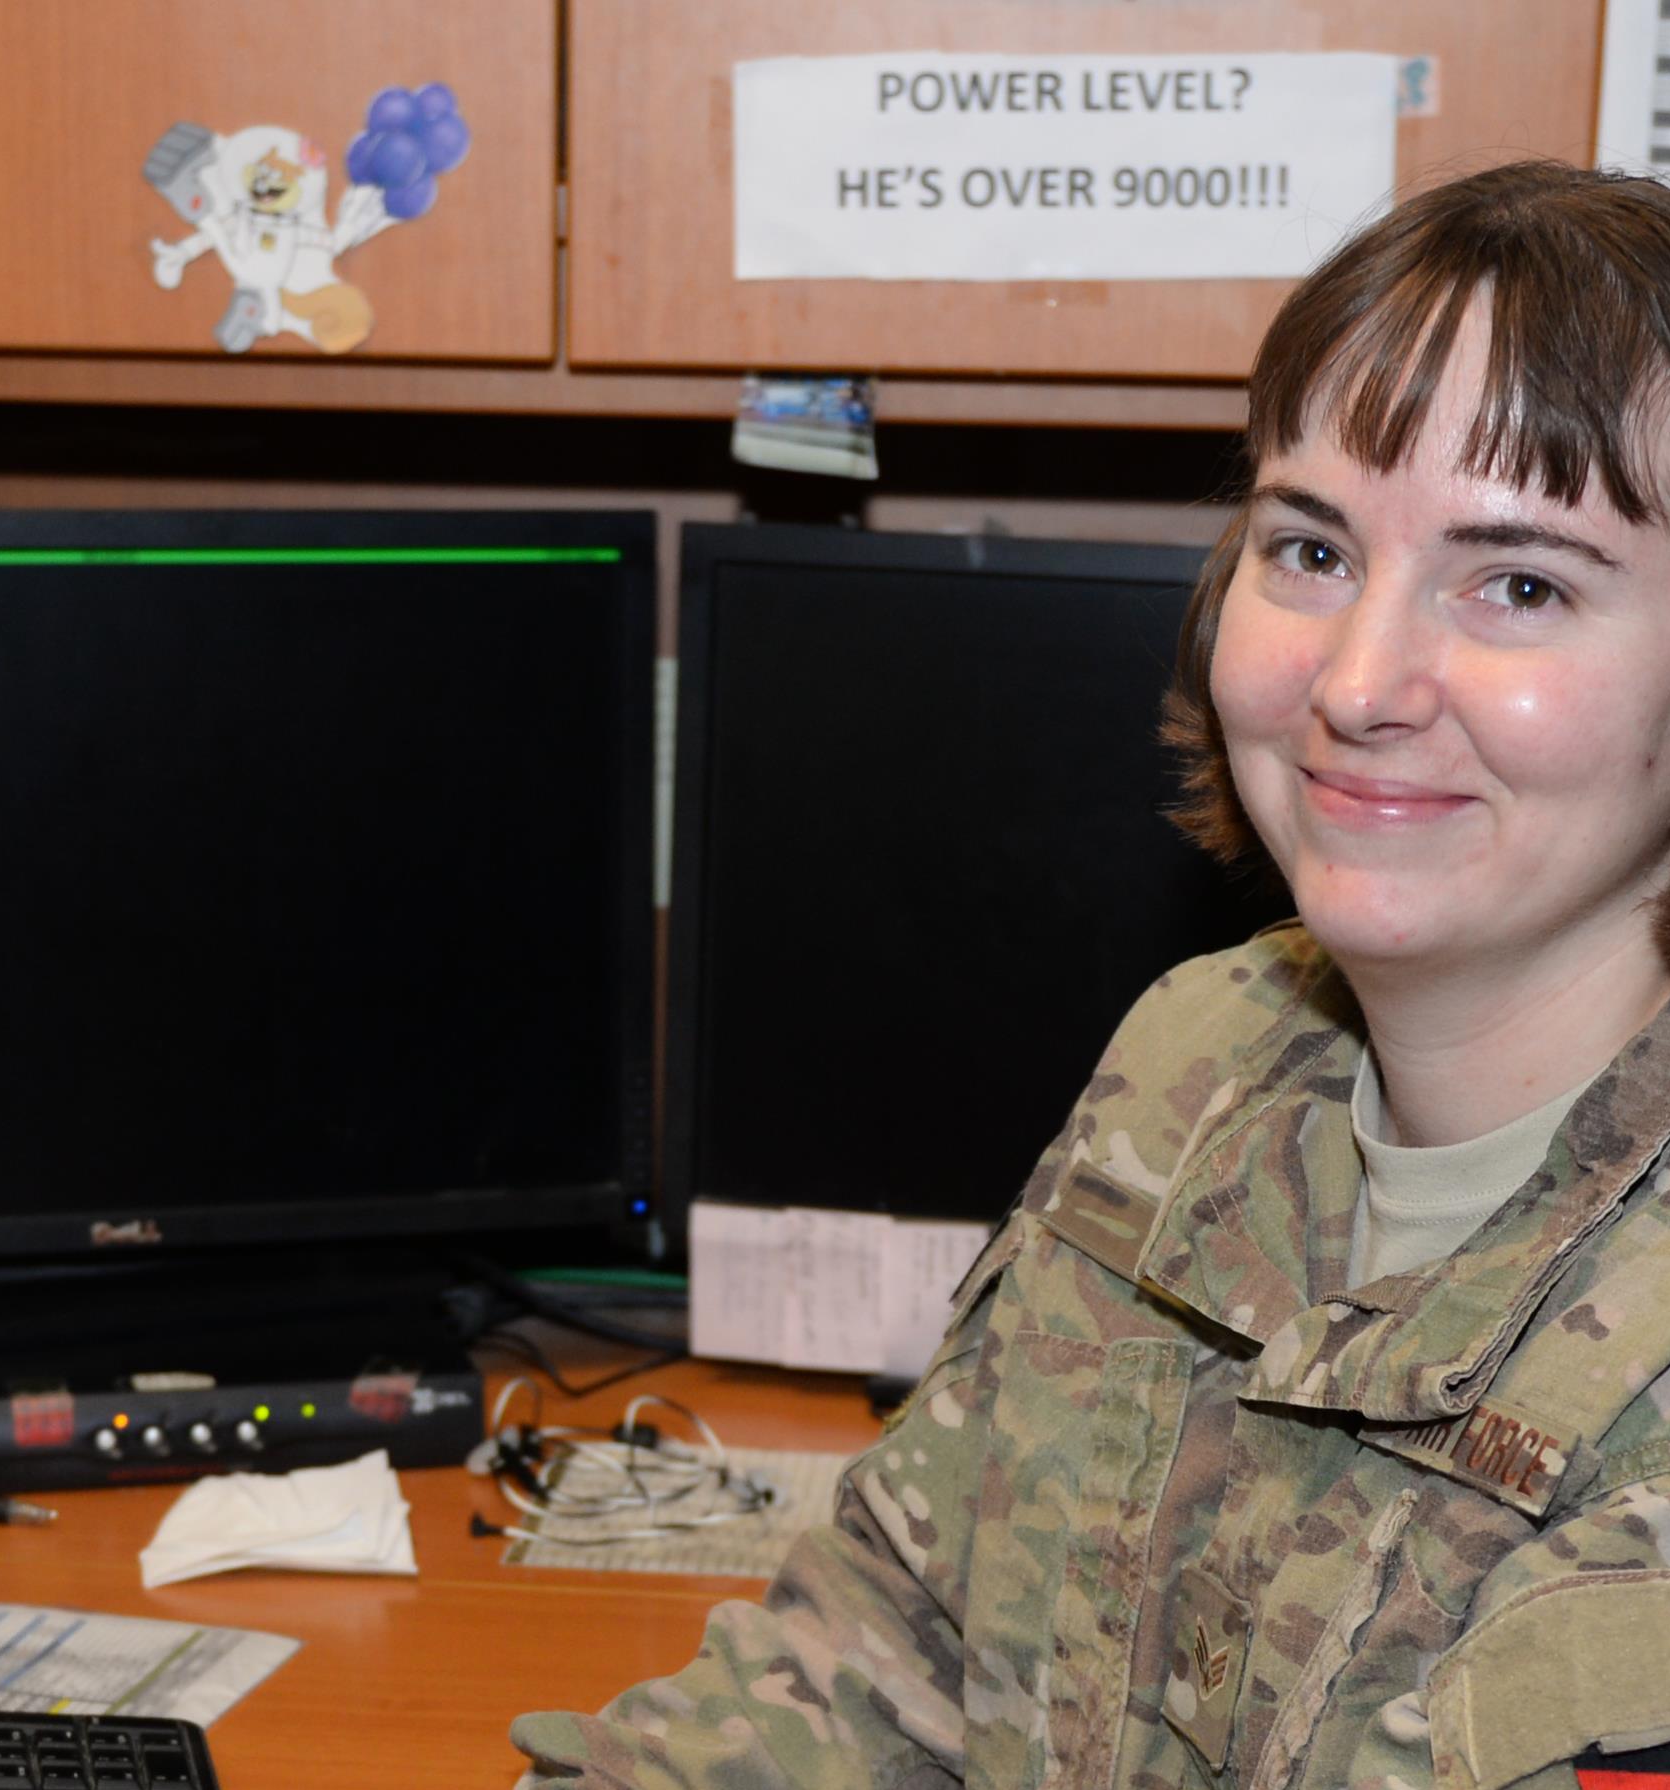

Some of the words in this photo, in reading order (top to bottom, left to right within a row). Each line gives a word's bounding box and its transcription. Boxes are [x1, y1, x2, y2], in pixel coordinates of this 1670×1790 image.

[877, 71, 1063, 112] POWER
[1082, 68, 1253, 112] LEVEL?
[837, 166, 944, 208] HE’S
[961, 167, 1095, 208] OVER
[1114, 165, 1289, 208] 9000!!!
[1451, 1406, 1561, 1498] FORCE
